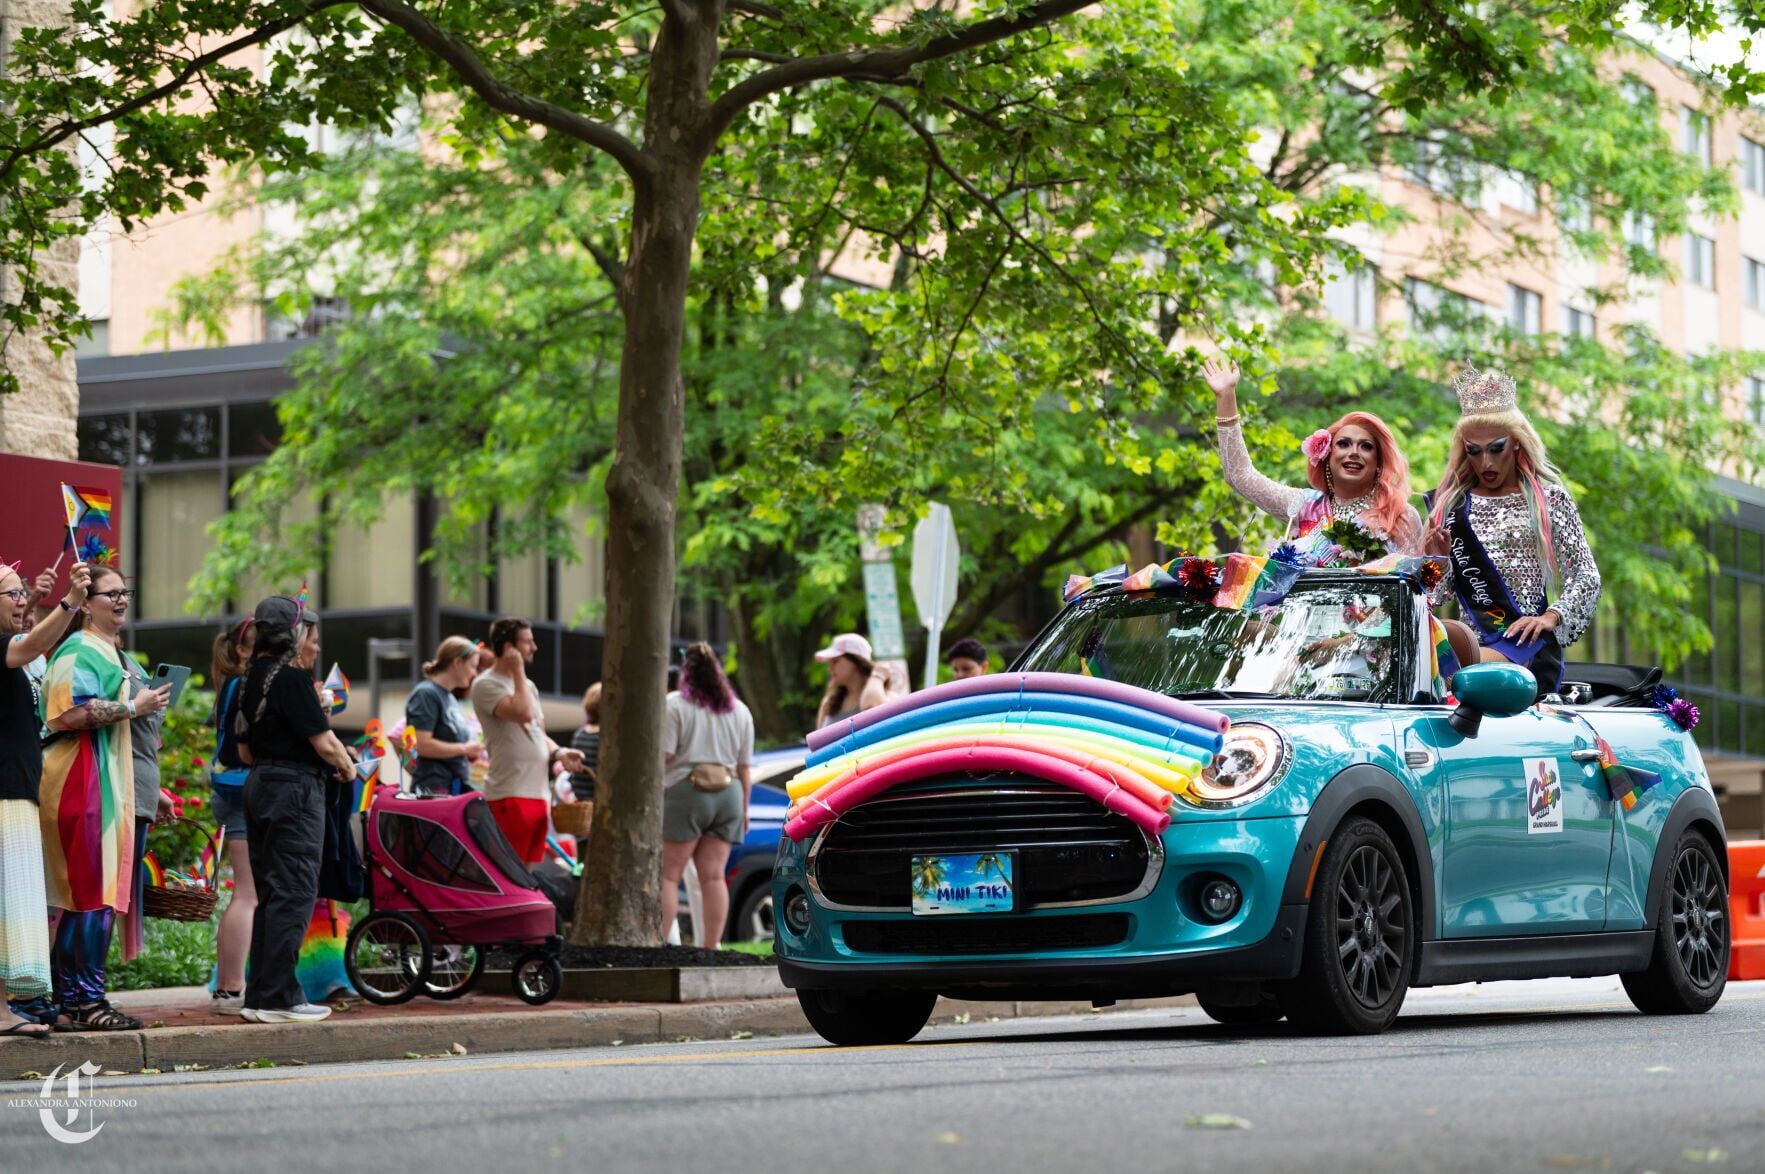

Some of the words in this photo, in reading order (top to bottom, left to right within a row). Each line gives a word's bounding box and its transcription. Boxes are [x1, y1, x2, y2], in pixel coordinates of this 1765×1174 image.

[1451, 537, 1470, 568] State
[1462, 567, 1493, 606] College
[1529, 777, 1561, 816] College
[937, 887, 971, 902] MINI
[975, 885, 1008, 900] TIKI
